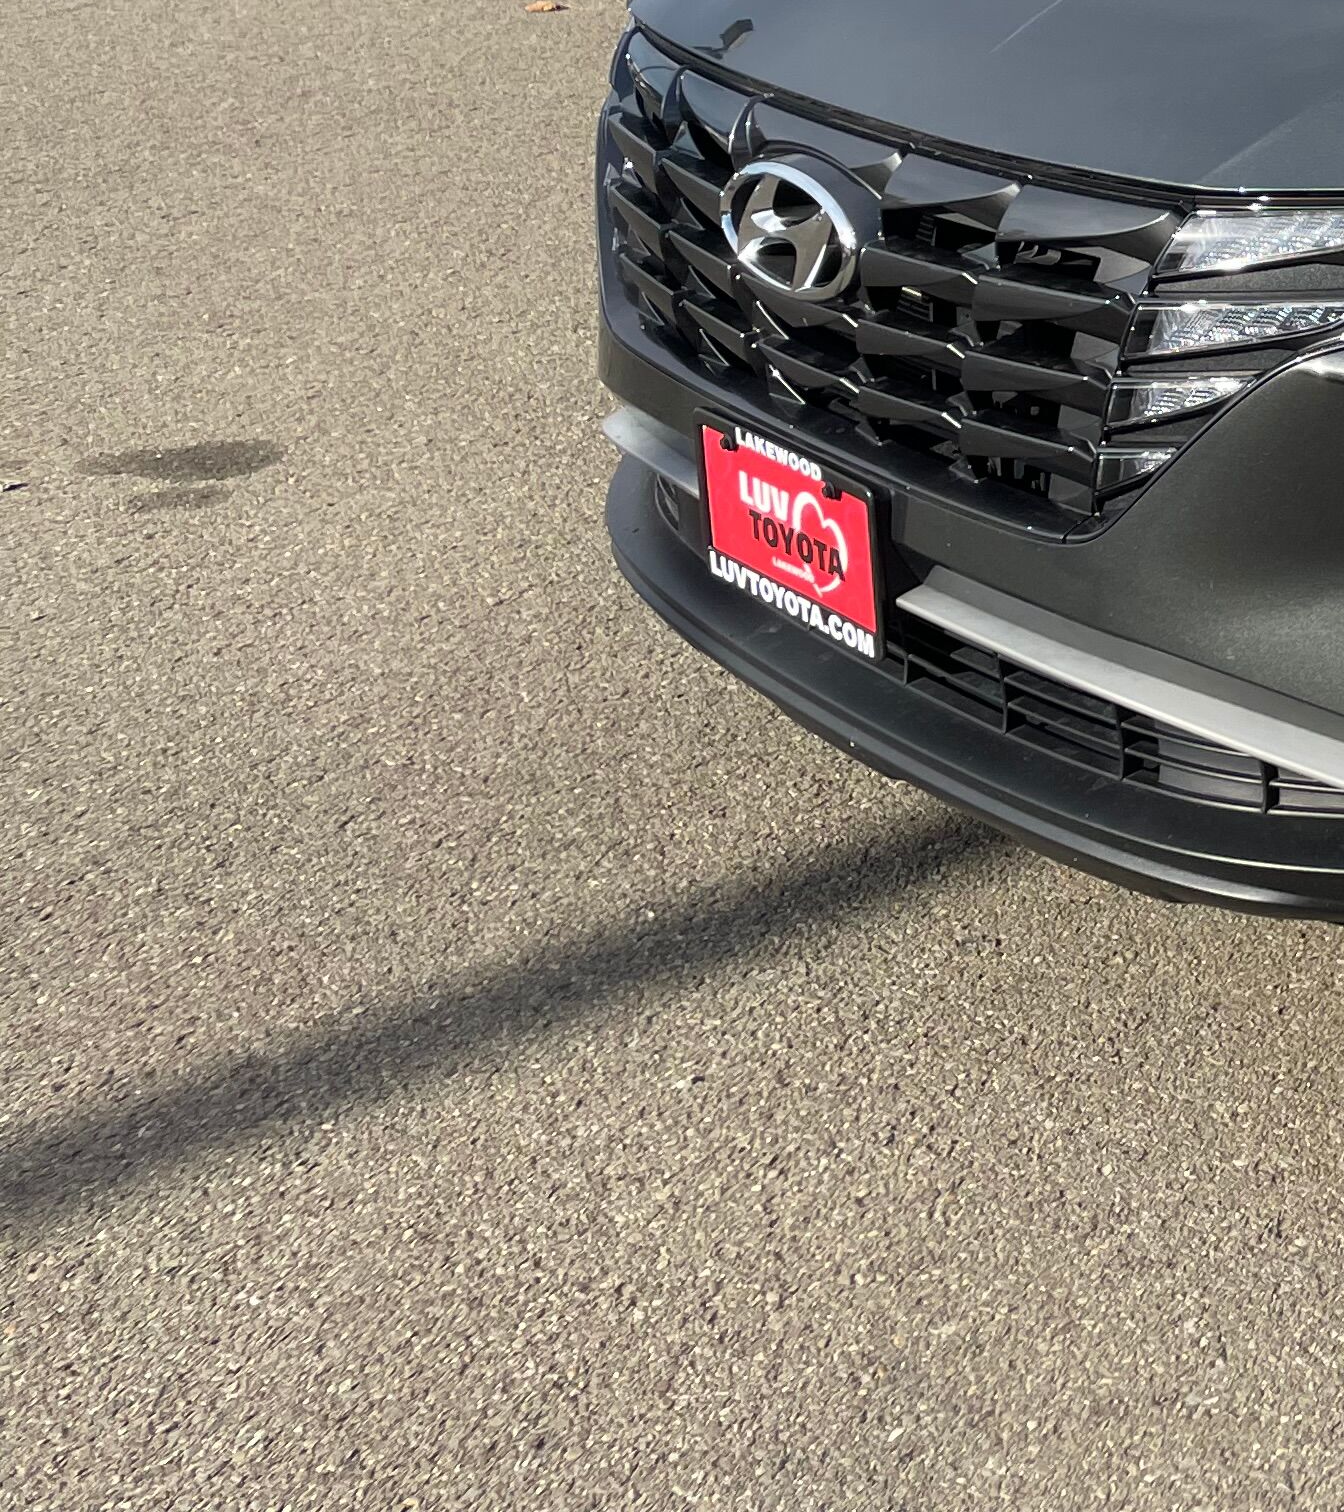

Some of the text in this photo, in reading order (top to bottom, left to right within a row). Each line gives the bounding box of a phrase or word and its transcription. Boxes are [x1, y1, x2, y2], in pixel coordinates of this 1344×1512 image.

[735, 426, 822, 481] LAKEWOOD
[738, 470, 790, 521] LUV
[749, 508, 846, 582] TOYOTA
[709, 549, 875, 659] LUVTOYOTA.COM
